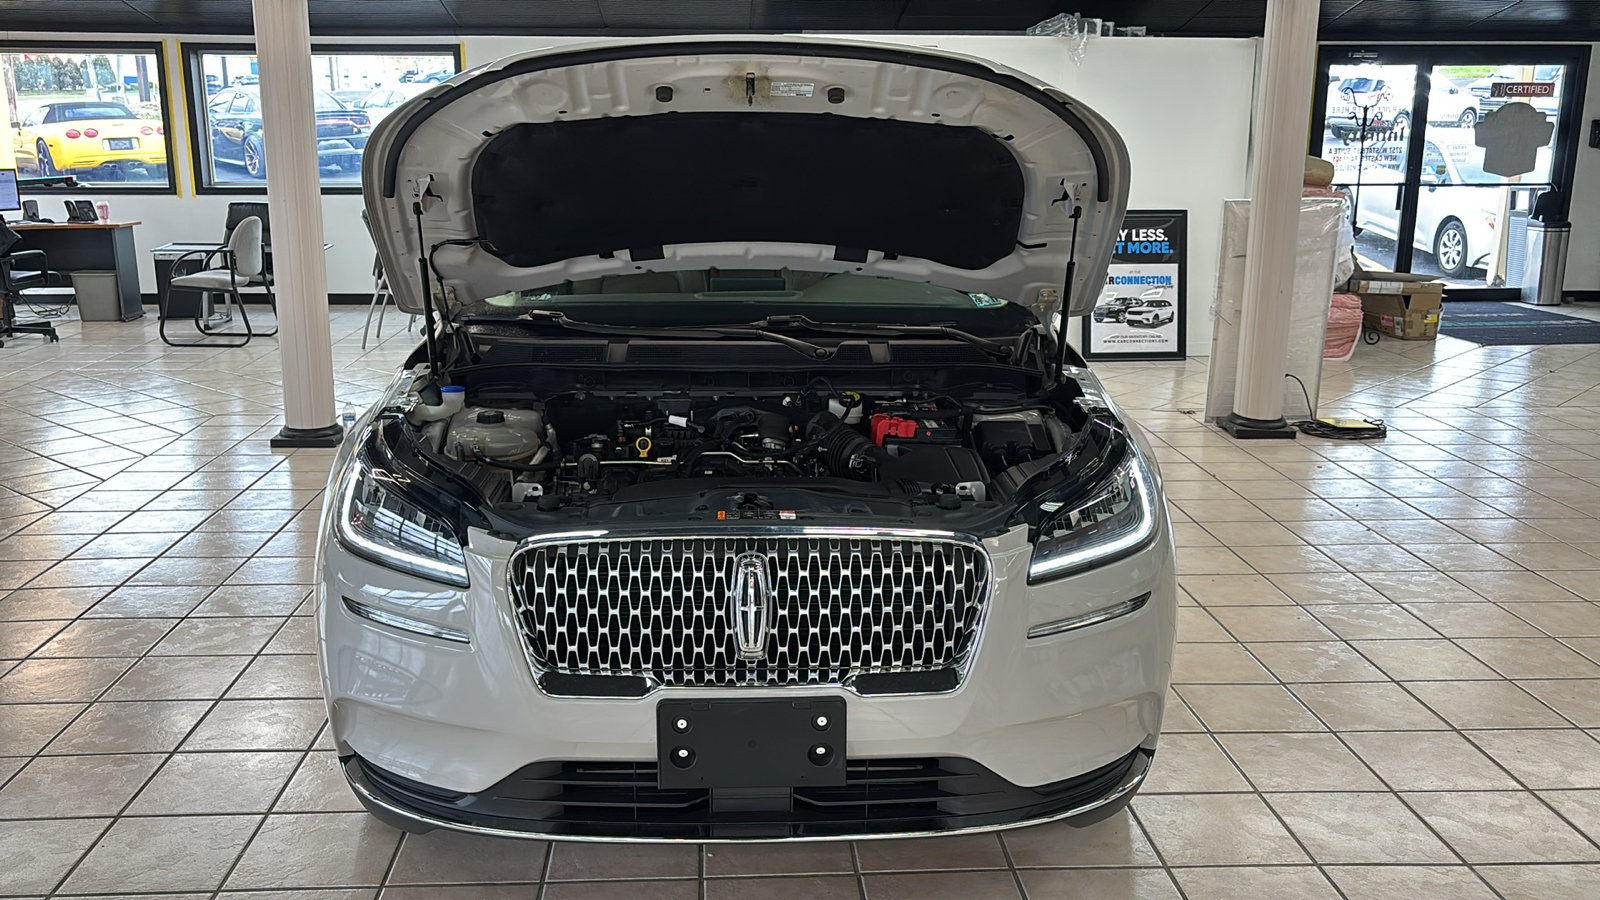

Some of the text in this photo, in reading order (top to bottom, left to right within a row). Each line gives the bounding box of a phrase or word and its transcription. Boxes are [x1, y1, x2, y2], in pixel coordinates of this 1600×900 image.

[1506, 85, 1550, 94] CERTIFIED
[1132, 229, 1168, 241] LESS.
[1127, 242, 1174, 253] MORE.
[1106, 276, 1172, 285] RCONNECTION
